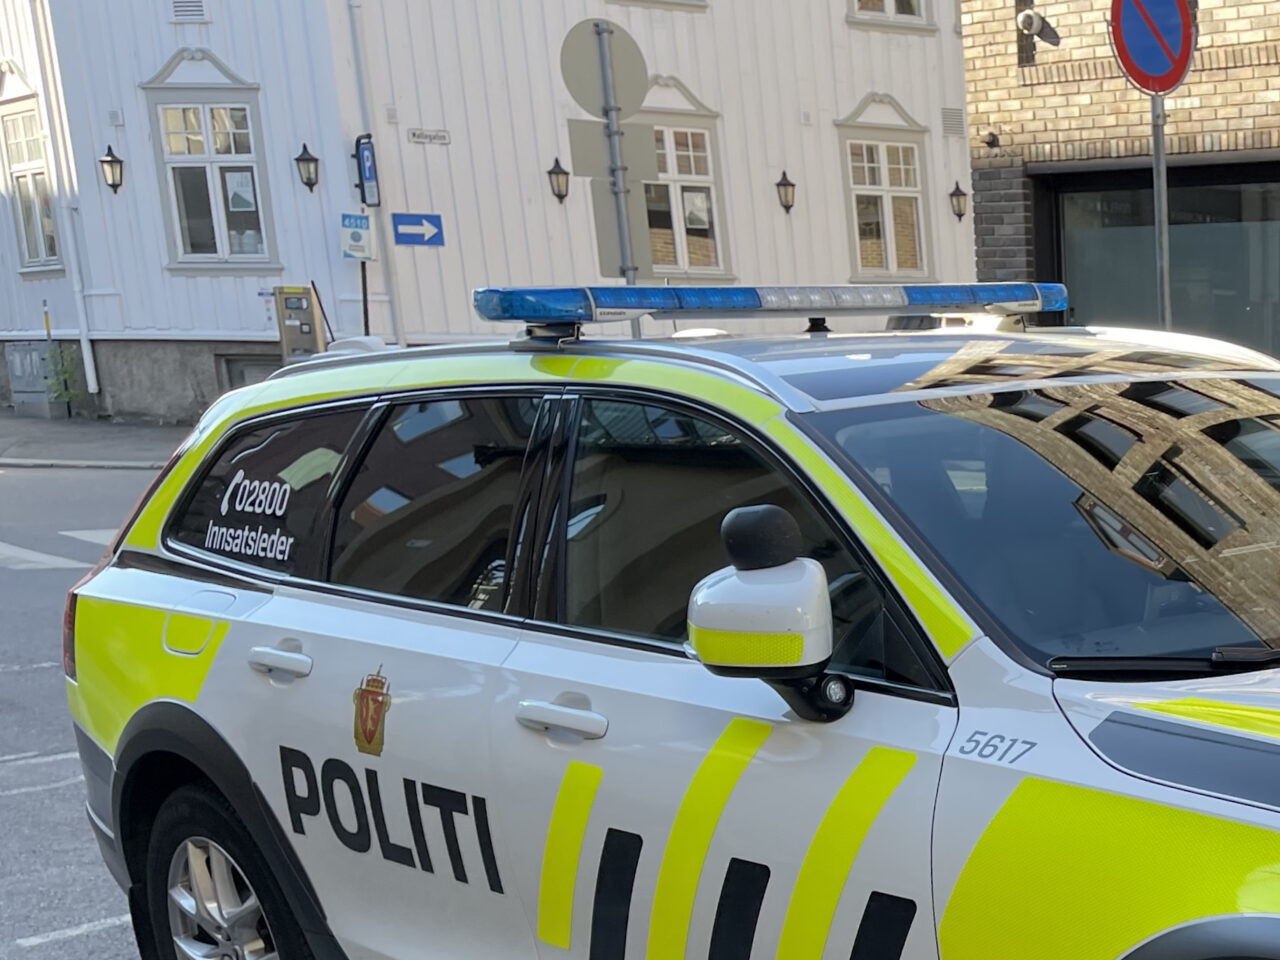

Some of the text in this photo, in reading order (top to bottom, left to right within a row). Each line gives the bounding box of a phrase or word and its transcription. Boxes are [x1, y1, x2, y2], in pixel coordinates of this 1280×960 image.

[363, 149, 373, 178] P
[235, 479, 291, 516] 02800
[204, 519, 295, 561] Innsatsleder
[958, 730, 1039, 764] 5617
[279, 745, 505, 895] POLITI
